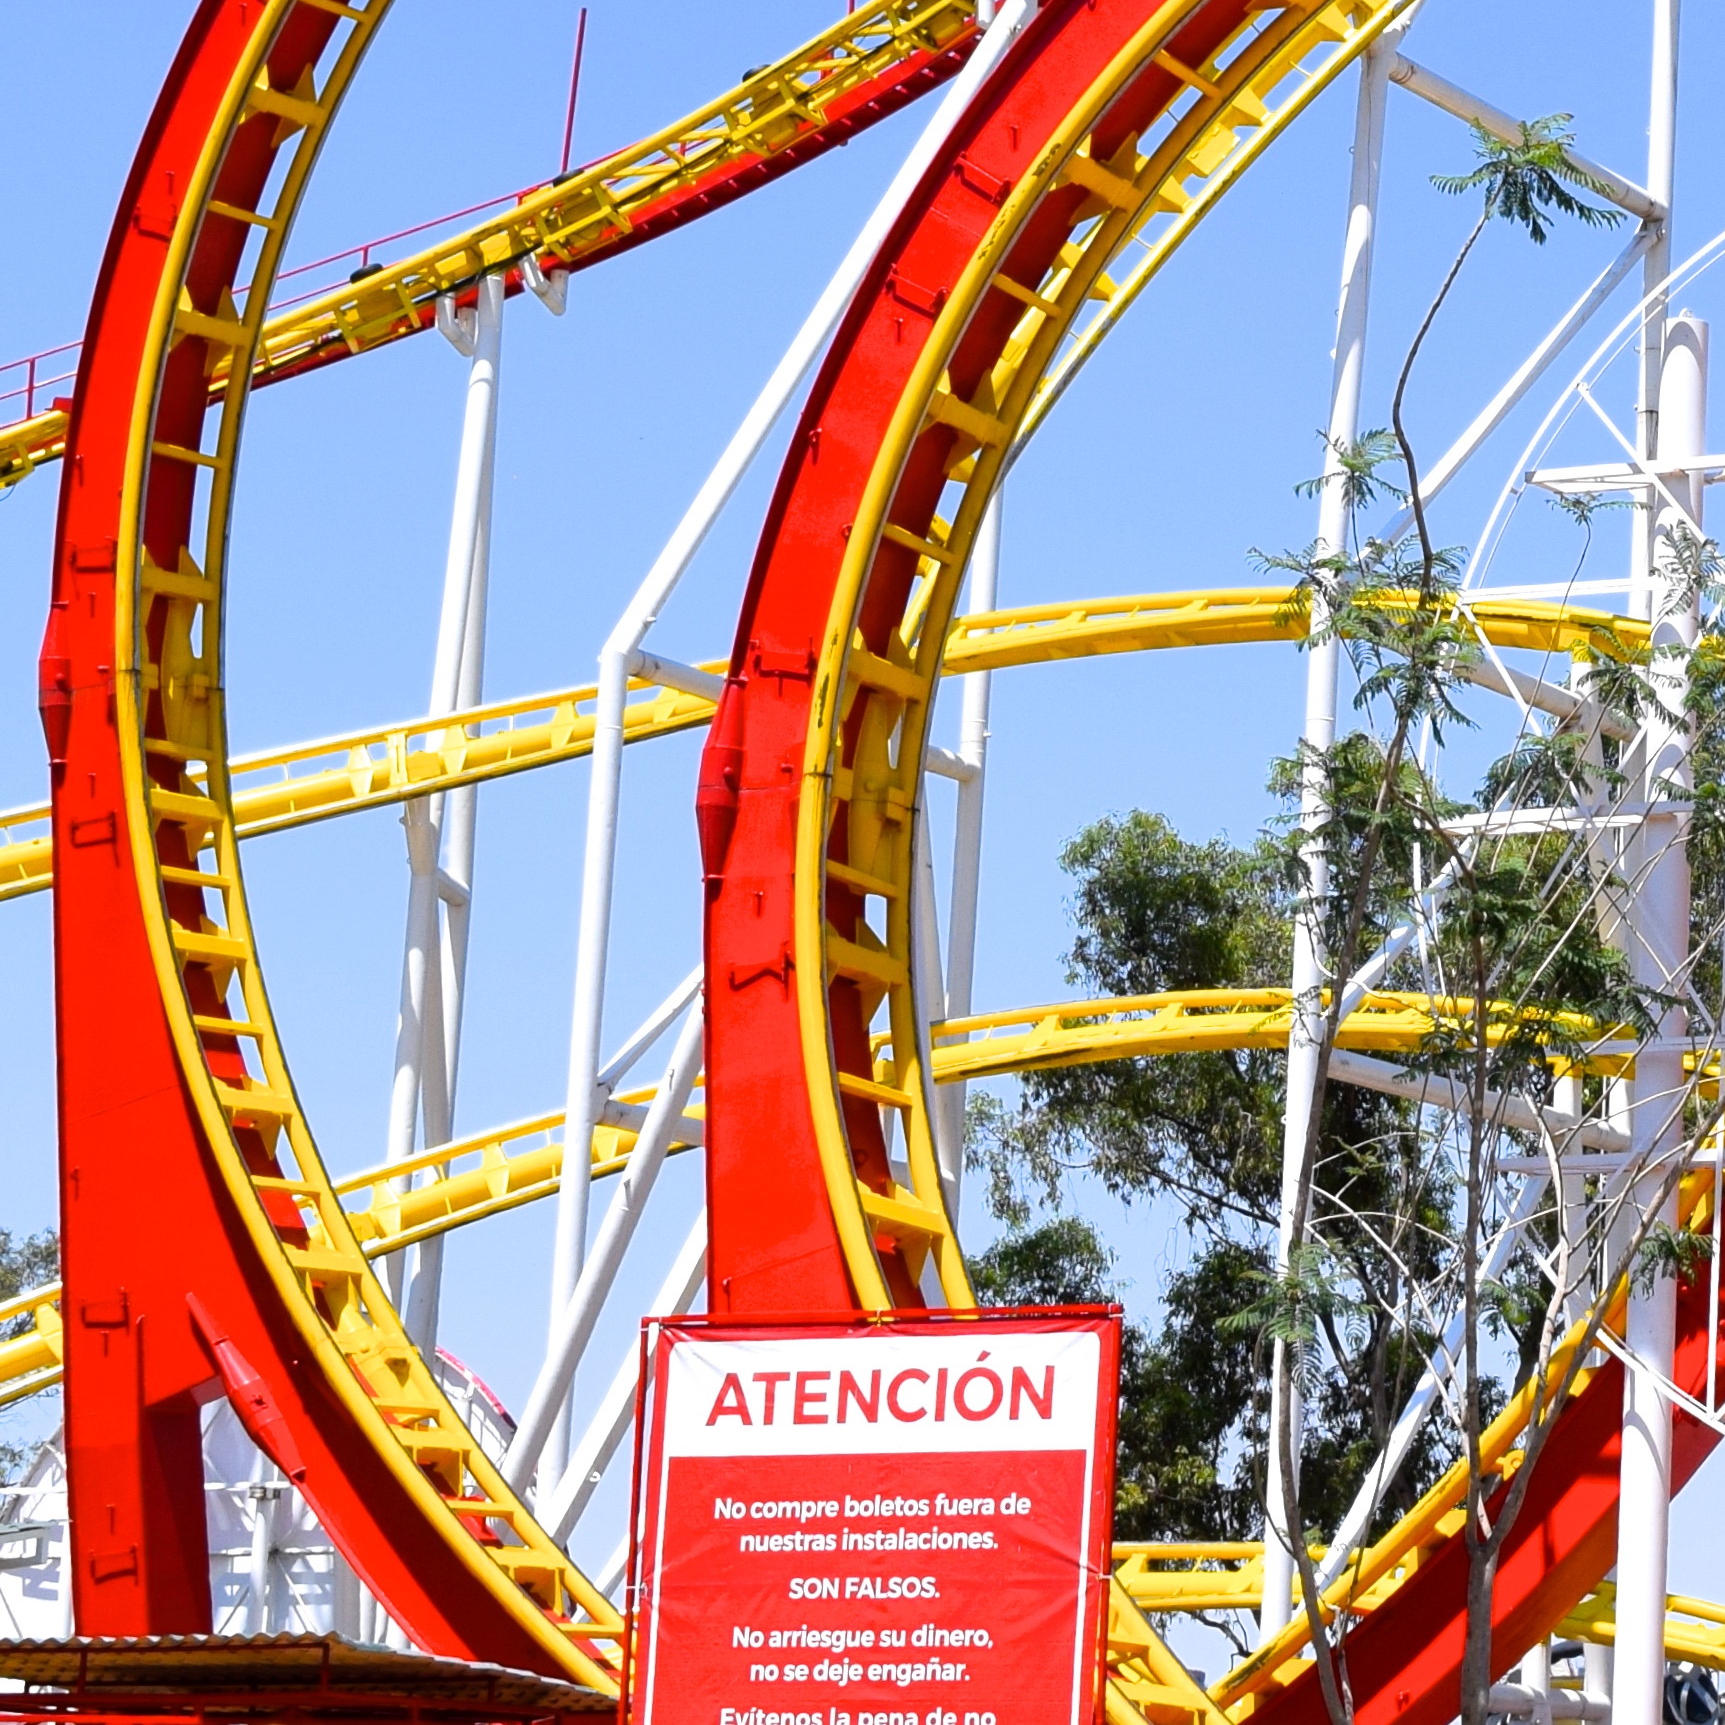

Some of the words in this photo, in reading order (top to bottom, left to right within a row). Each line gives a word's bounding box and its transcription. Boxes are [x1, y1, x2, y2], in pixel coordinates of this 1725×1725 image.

[705, 1350, 1056, 1427] ATENCIÓN
[714, 1497, 746, 1520] No
[749, 1500, 840, 1524] compre
[843, 1493, 930, 1518] boletos
[934, 1492, 994, 1517] fuera
[999, 1492, 1032, 1515] de
[739, 1530, 838, 1552] nuestras
[841, 1525, 999, 1552] instalaciones.
[788, 1577, 841, 1600] SON
[844, 1576, 941, 1599] FALSOS.
[732, 1626, 765, 1648] No
[768, 1625, 874, 1654] arriesgue
[878, 1629, 907, 1648] su
[910, 1623, 994, 1652] dinero,
[749, 1664, 780, 1683] no
[782, 1663, 811, 1682] se
[812, 1658, 864, 1687] deje
[867, 1656, 971, 1687] engañar.
[719, 1706, 824, 1725] Evítenos
[829, 1706, 851, 1725] la
[857, 1712, 919, 1725] pena
[925, 1706, 958, 1725] de
[964, 1712, 998, 1725] no
